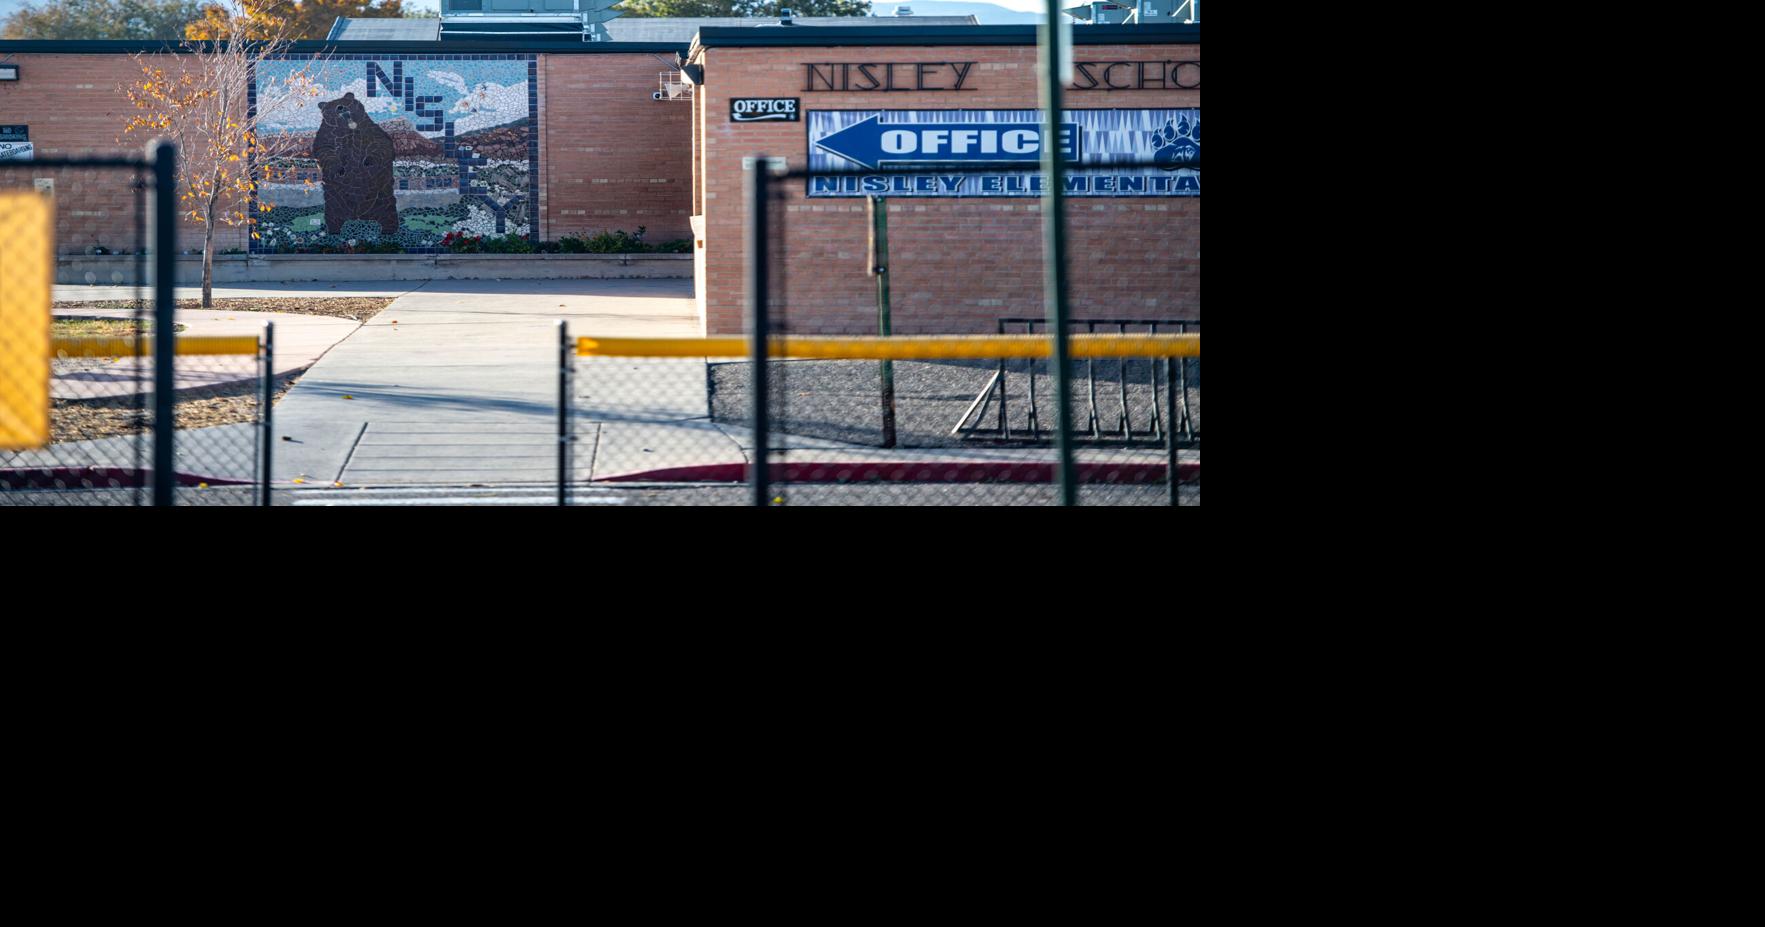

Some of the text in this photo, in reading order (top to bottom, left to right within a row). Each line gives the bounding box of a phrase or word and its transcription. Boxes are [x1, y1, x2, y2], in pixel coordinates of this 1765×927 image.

[803, 62, 976, 91] NISLEY
[734, 99, 796, 113] OFFICE
[366, 61, 527, 234] NISLEY
[881, 129, 1072, 154] OFFICE
[814, 175, 966, 193] NISLEY
